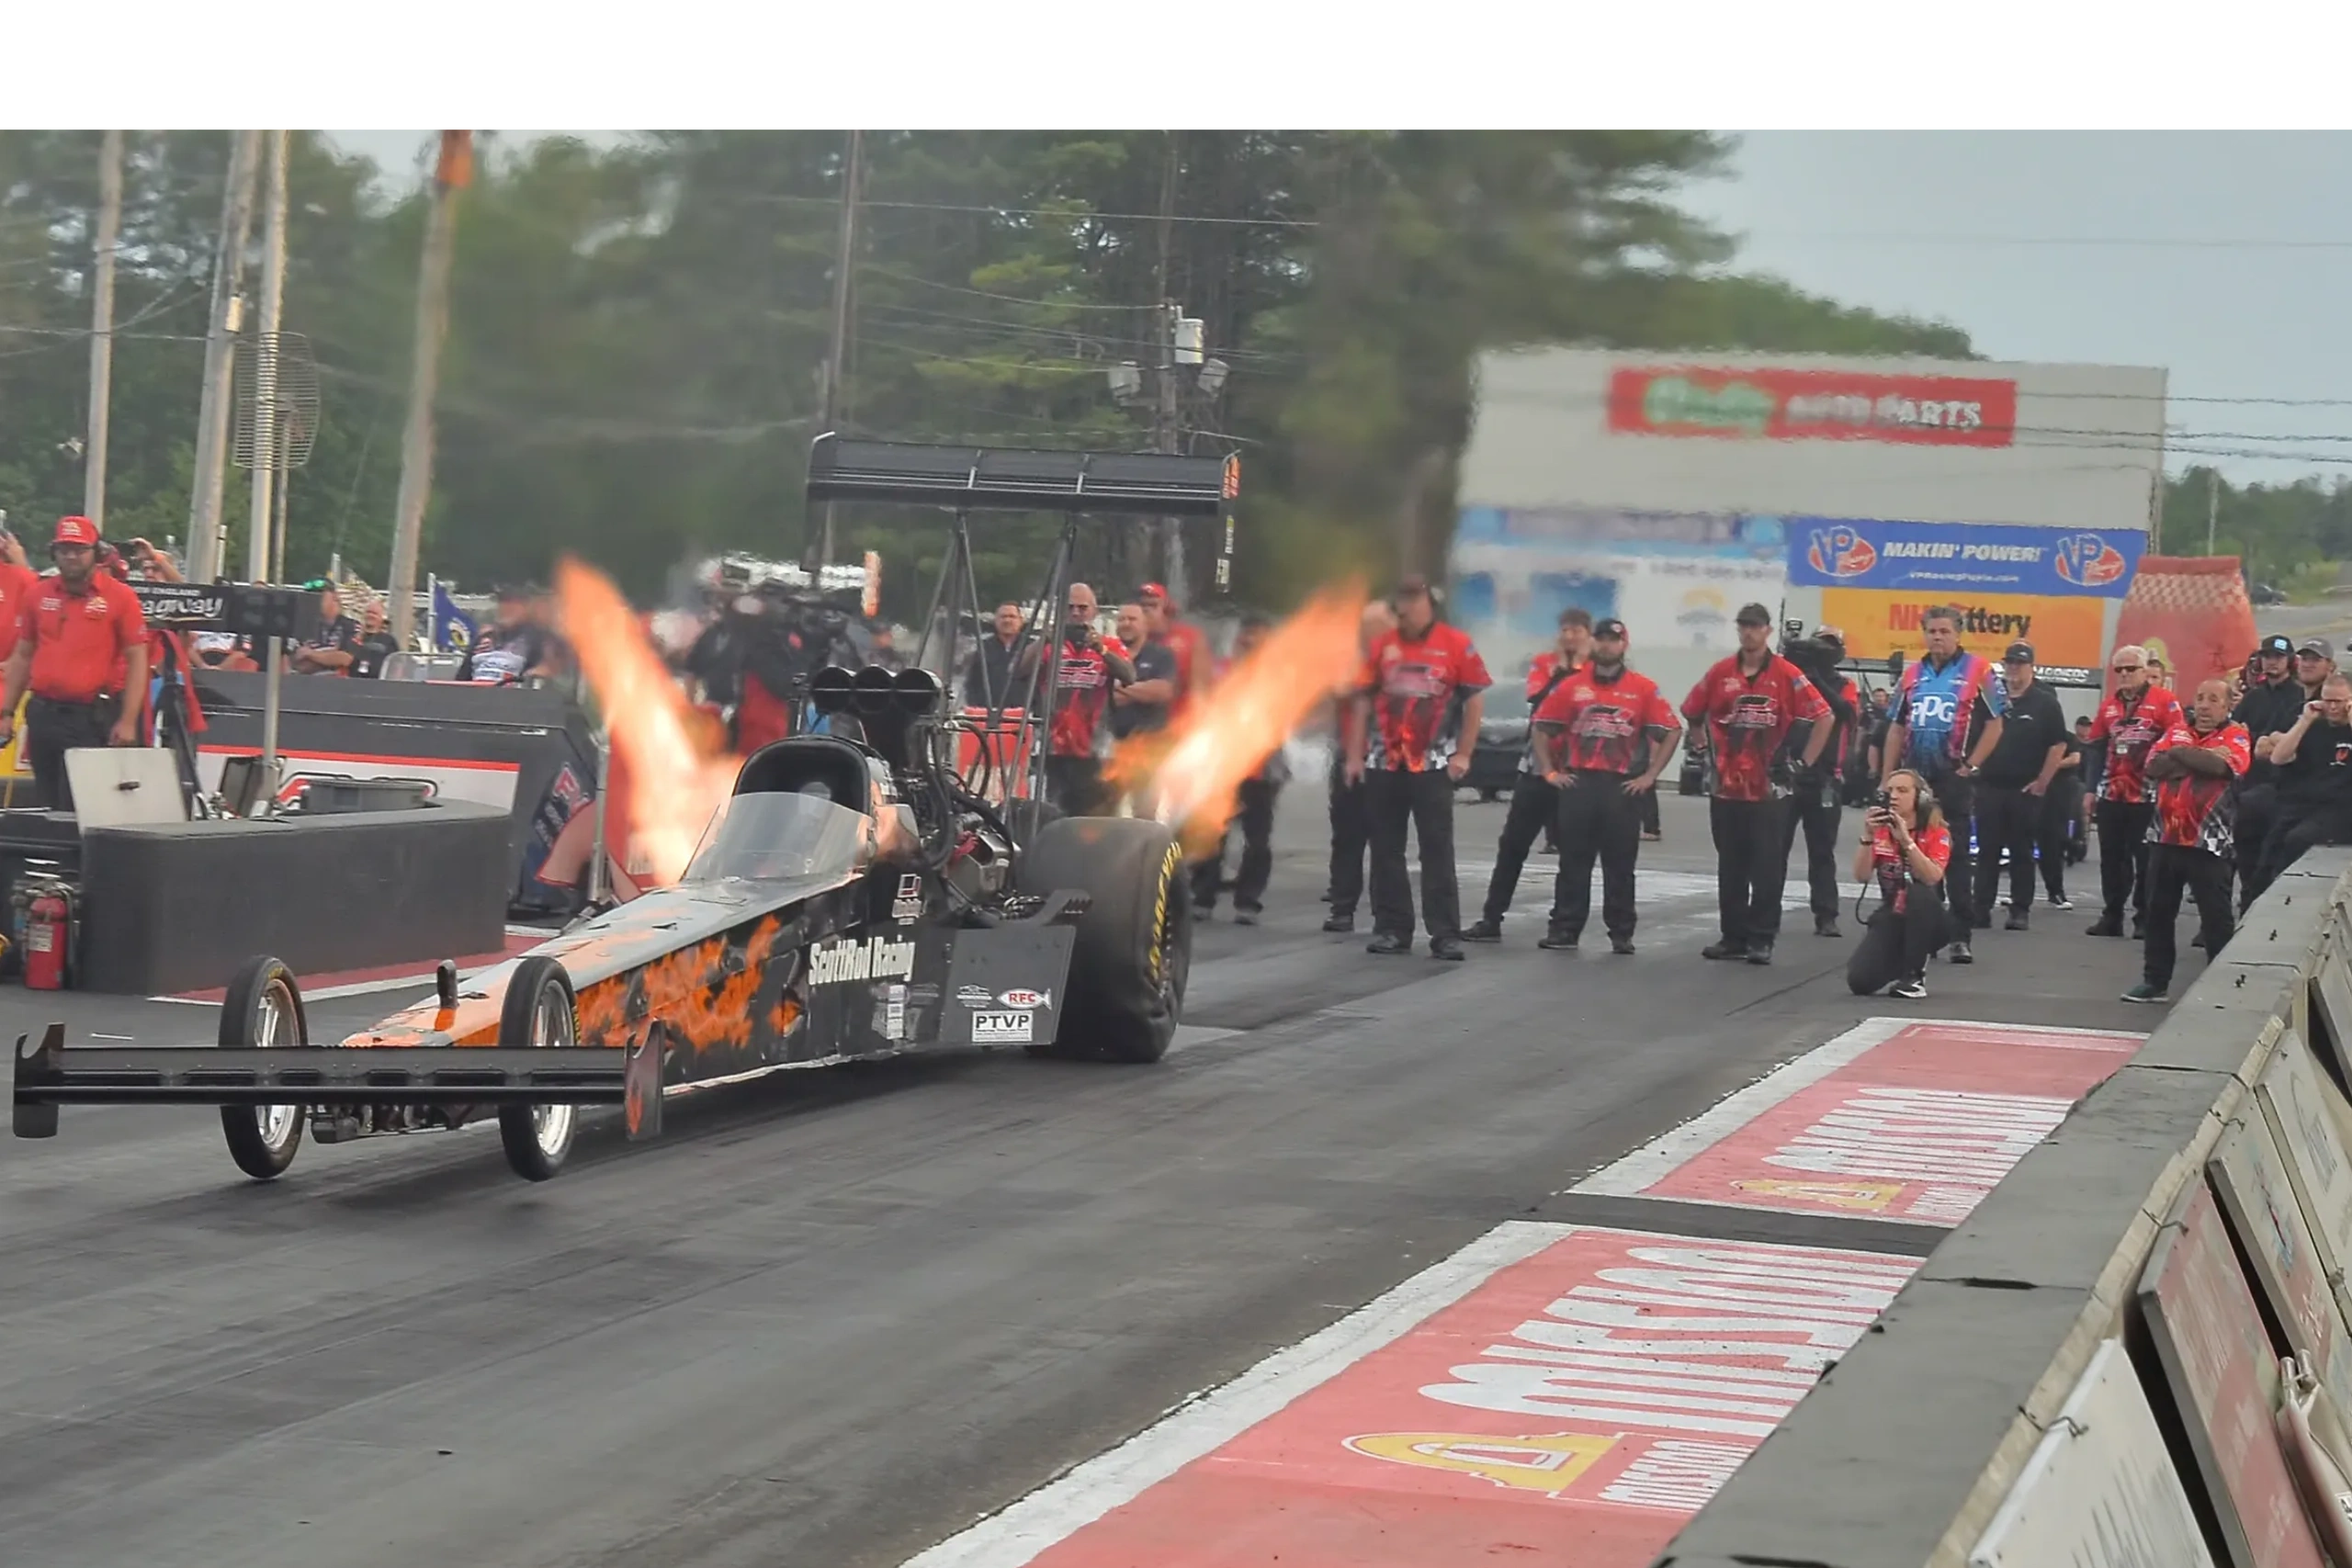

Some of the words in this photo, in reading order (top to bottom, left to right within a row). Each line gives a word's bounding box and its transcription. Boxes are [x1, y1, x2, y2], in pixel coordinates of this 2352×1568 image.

[1883, 542, 1960, 558] MAKIN'
[1962, 544, 2041, 562] POWER!
[1009, 993, 1035, 1002] RFC
[976, 1015, 1029, 1029] PTVP
